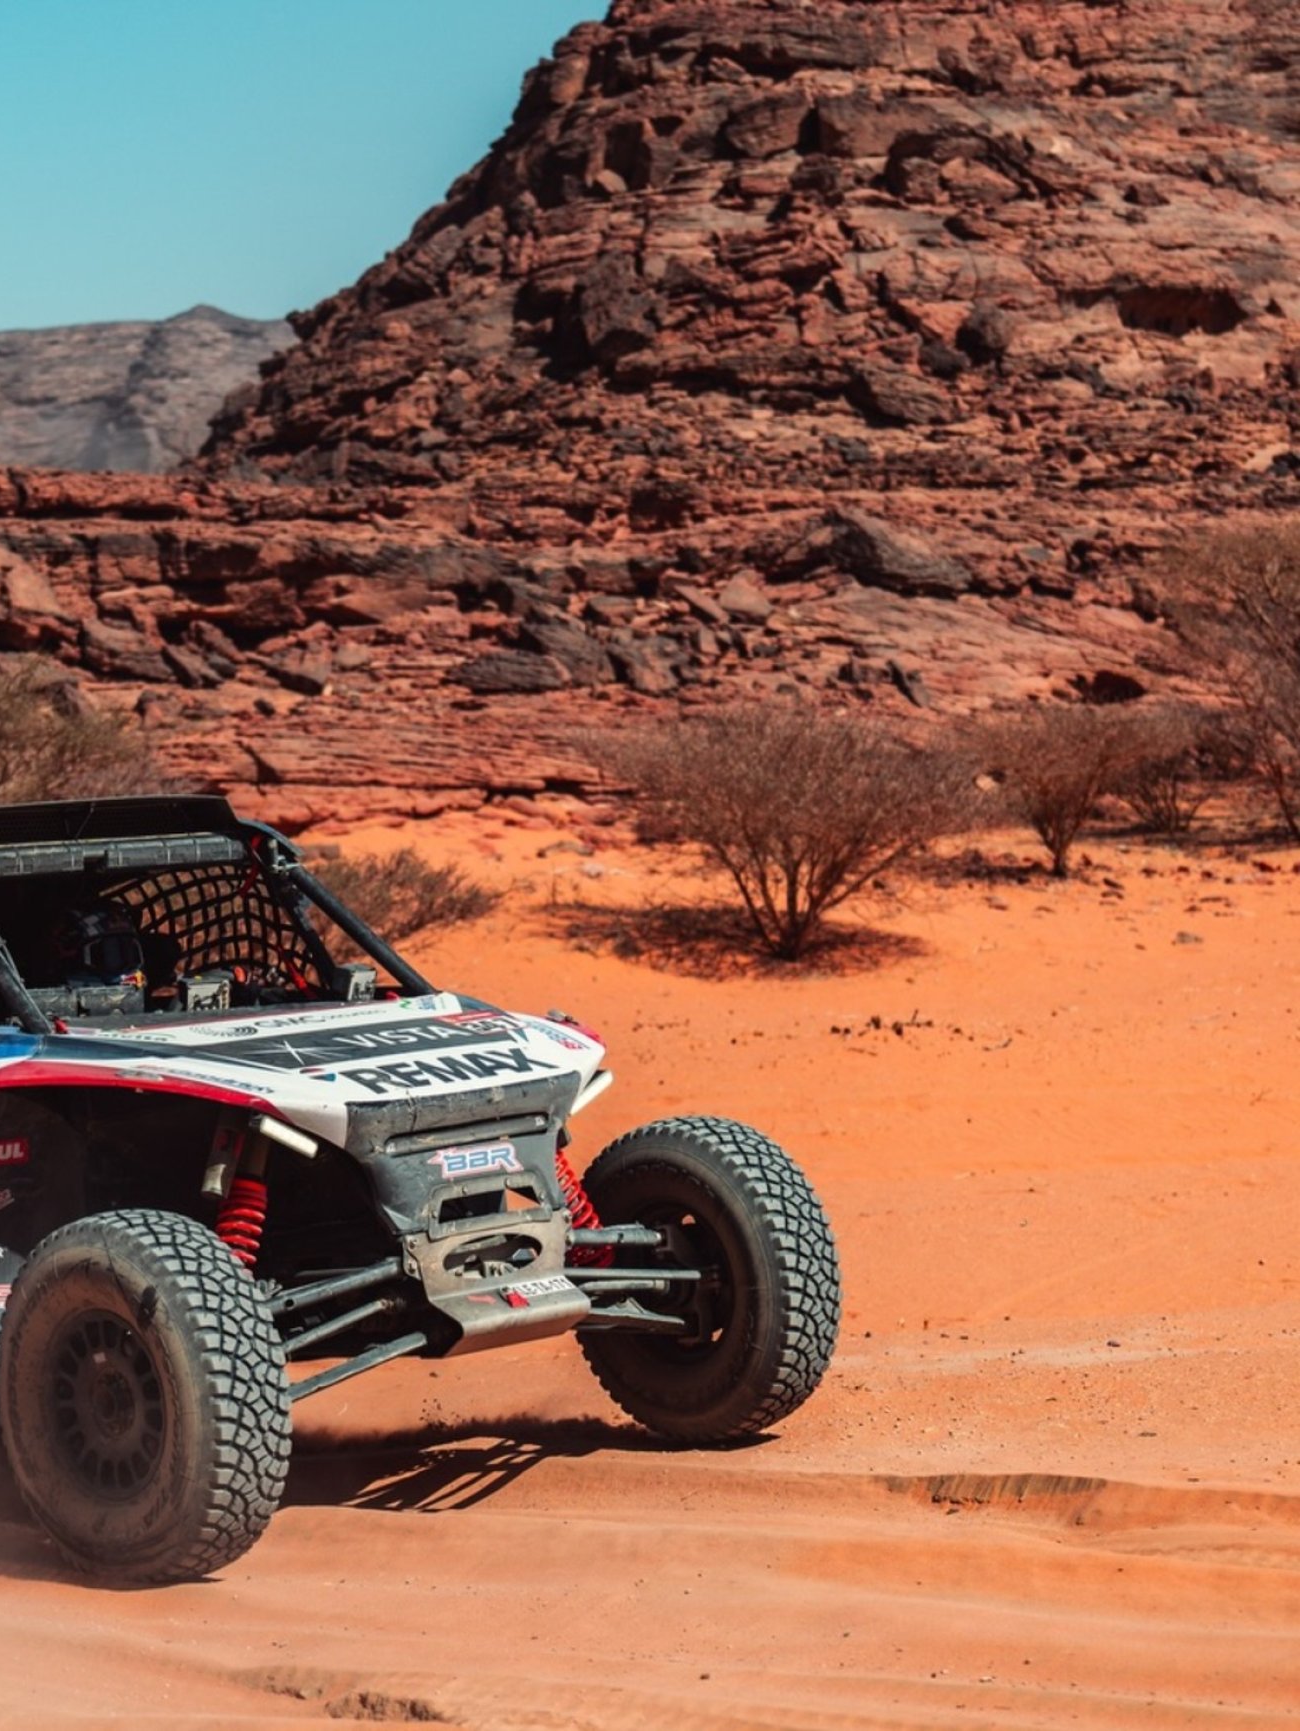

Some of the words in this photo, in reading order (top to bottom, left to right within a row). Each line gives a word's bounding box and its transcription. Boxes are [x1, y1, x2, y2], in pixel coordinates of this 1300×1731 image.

[332, 1025, 469, 1048] VISTA
[338, 1048, 560, 1094] REMAX
[444, 1147, 516, 1172] BBR
